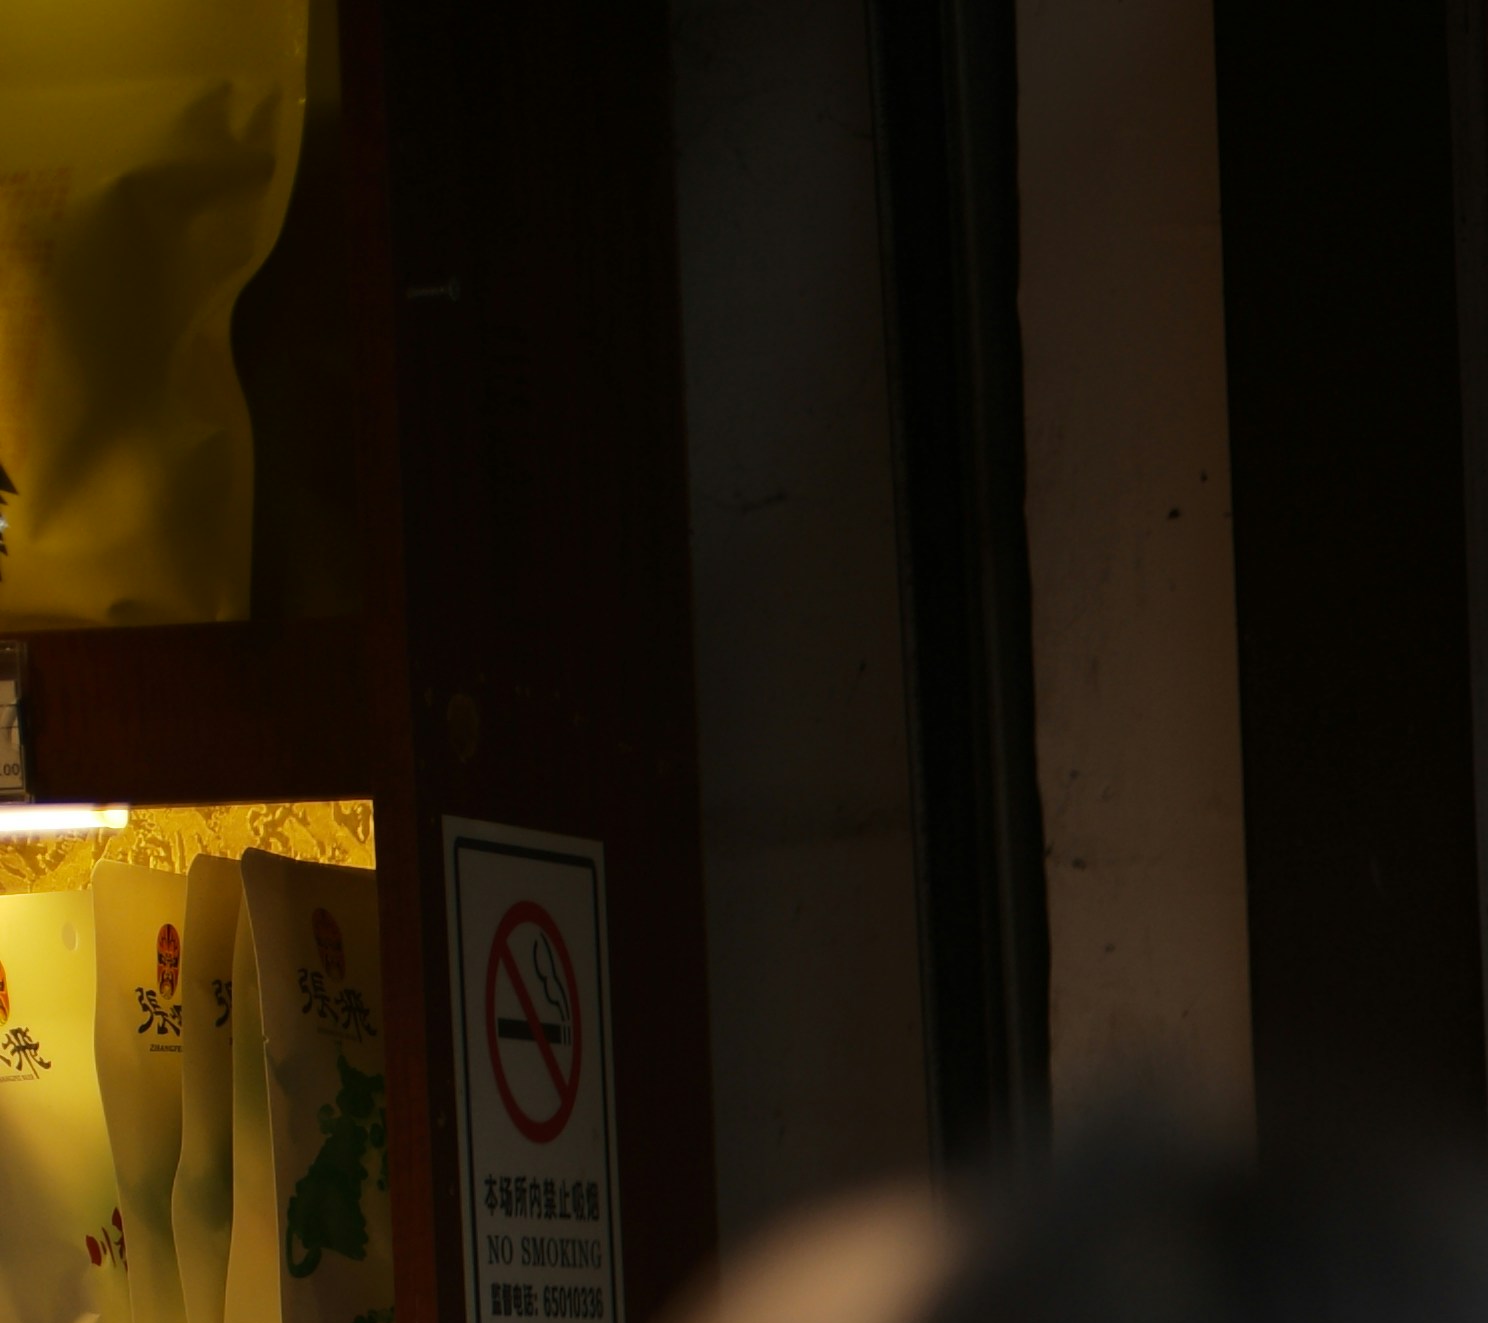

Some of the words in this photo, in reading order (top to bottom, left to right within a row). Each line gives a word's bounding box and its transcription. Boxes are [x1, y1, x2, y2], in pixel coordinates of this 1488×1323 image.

[484, 1173, 599, 1222] 本场所内禁止吸烟
[487, 1235, 513, 1265] NO
[521, 1236, 602, 1269] SMOKING
